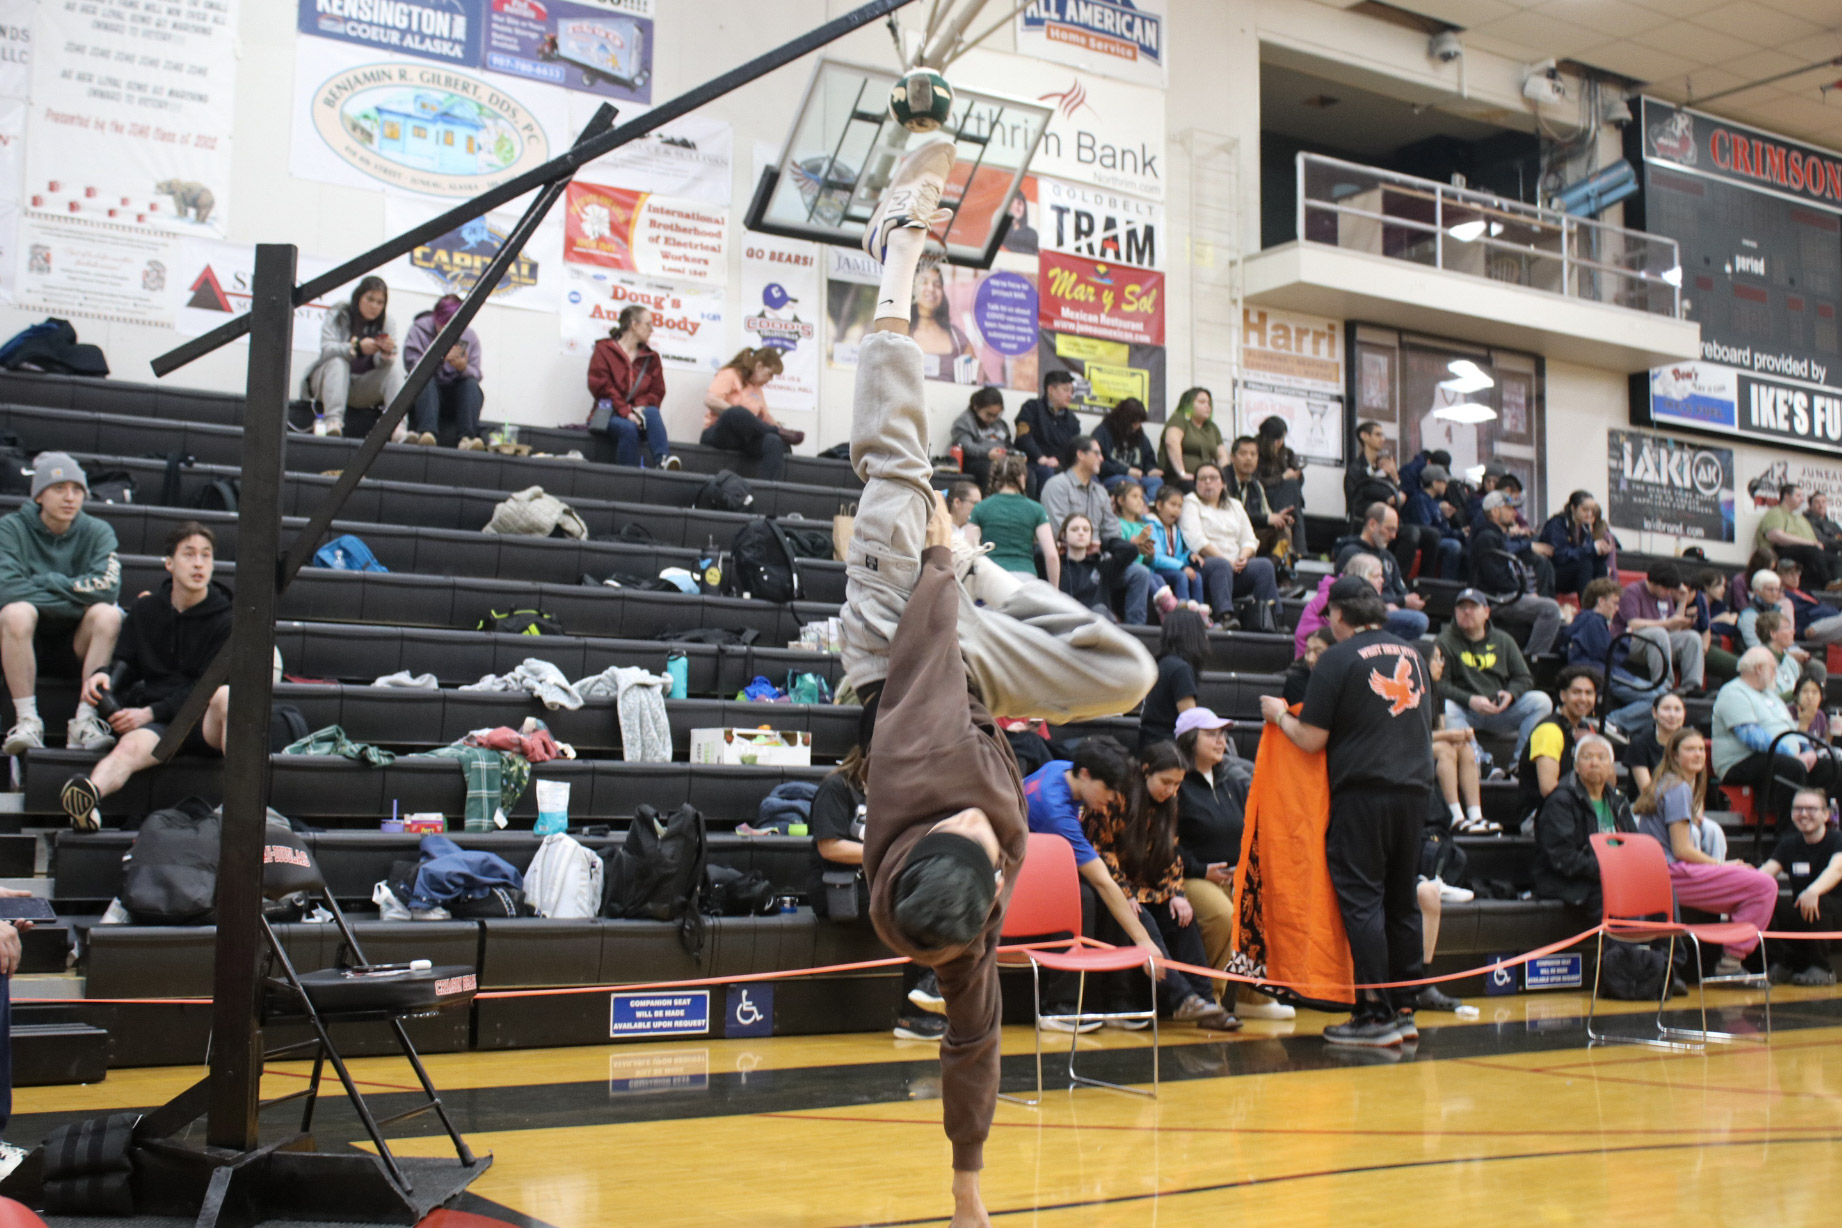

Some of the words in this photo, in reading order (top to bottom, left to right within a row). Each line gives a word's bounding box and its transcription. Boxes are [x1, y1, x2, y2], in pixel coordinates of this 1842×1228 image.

[316, 0, 450, 39] KENSINGTON
[1025, 0, 1061, 20] ALL
[1065, 0, 1158, 51] AMERICAN
[346, 21, 402, 46] COEUR
[402, 33, 465, 59] ALASKA
[1050, 27, 1087, 45] Home
[1088, 36, 1134, 58] Service
[323, 68, 393, 109] BENJAMIN
[398, 68, 413, 82] R.
[419, 70, 481, 100] GILBERT,
[488, 91, 519, 124] DDS,
[522, 123, 541, 146] PC
[1077, 130, 1160, 180] Bank
[1709, 128, 1842, 200] CRIMSON
[647, 203, 725, 226] International
[1052, 184, 1156, 217] GOLDBELT
[648, 234, 660, 245] of
[664, 236, 721, 254] Electrical
[649, 218, 723, 240] Brotherhood
[1050, 203, 1156, 267] TRAM
[413, 245, 538, 286] CAPIAL
[661, 250, 709, 266] Workers
[746, 247, 765, 260] GO
[769, 250, 814, 267] BEARS!
[1735, 253, 1765, 276] period
[610, 284, 681, 310] Doug's
[1048, 266, 1096, 303] Mar
[1102, 288, 1115, 315] y
[1121, 283, 1157, 314] Sol
[589, 303, 619, 321] Au
[650, 311, 701, 337] Body
[1061, 305, 1099, 324] Mexican
[1100, 312, 1144, 332] Restaurant
[1700, 339, 1750, 367] reboard
[1753, 351, 1808, 378] provided
[1811, 359, 1827, 385] by
[1750, 382, 1810, 436] IKE'S
[1813, 395, 1842, 442] FU
[629, 999, 673, 1008] COMPANION
[673, 998, 692, 1007] SEAT
[635, 1010, 653, 1019] WILL
[654, 1009, 664, 1018] BE
[664, 1008, 685, 1017] MADE
[613, 1021, 652, 1030] AVAILABLE
[652, 1020, 673, 1029] UPON
[674, 1019, 706, 1028] REQUEST
